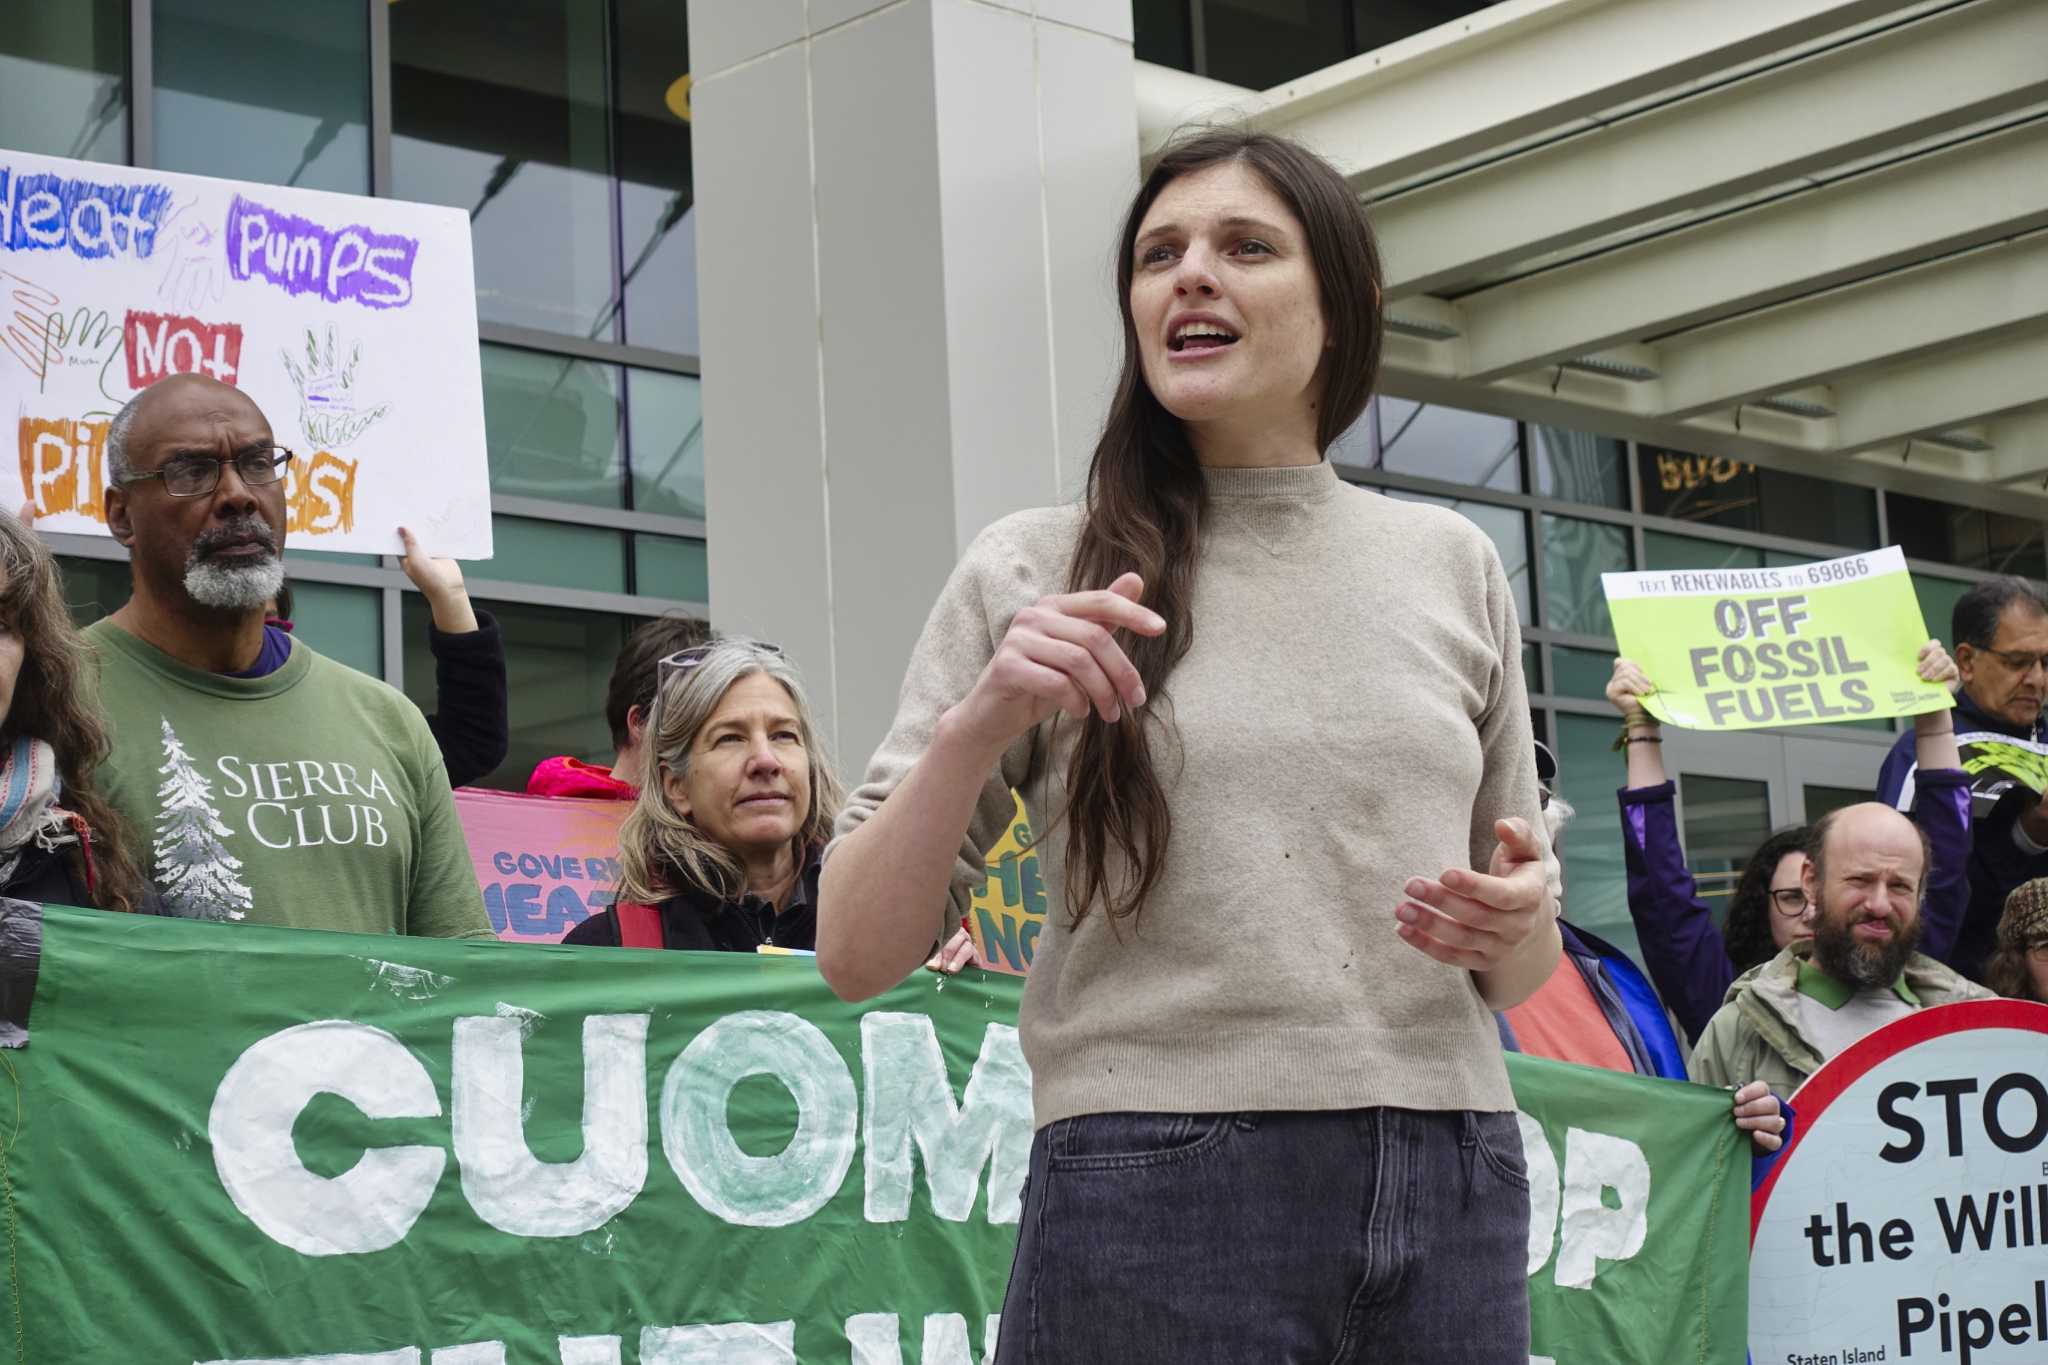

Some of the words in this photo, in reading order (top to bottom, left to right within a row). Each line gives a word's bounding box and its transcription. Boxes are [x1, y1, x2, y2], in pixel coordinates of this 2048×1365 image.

[1670, 571, 1783, 592] RENEWABLES
[1788, 574, 1804, 587] TO
[1807, 557, 1869, 585] 69866
[1713, 595, 1809, 639] OFF
[1689, 636, 1870, 687] FOSSIL
[1705, 679, 1875, 725] FUELS
[216, 755, 399, 807] SIERRA
[247, 802, 388, 849] CLUB
[1804, 1202, 1915, 1268] the
[1842, 1345, 1886, 1365] Island
